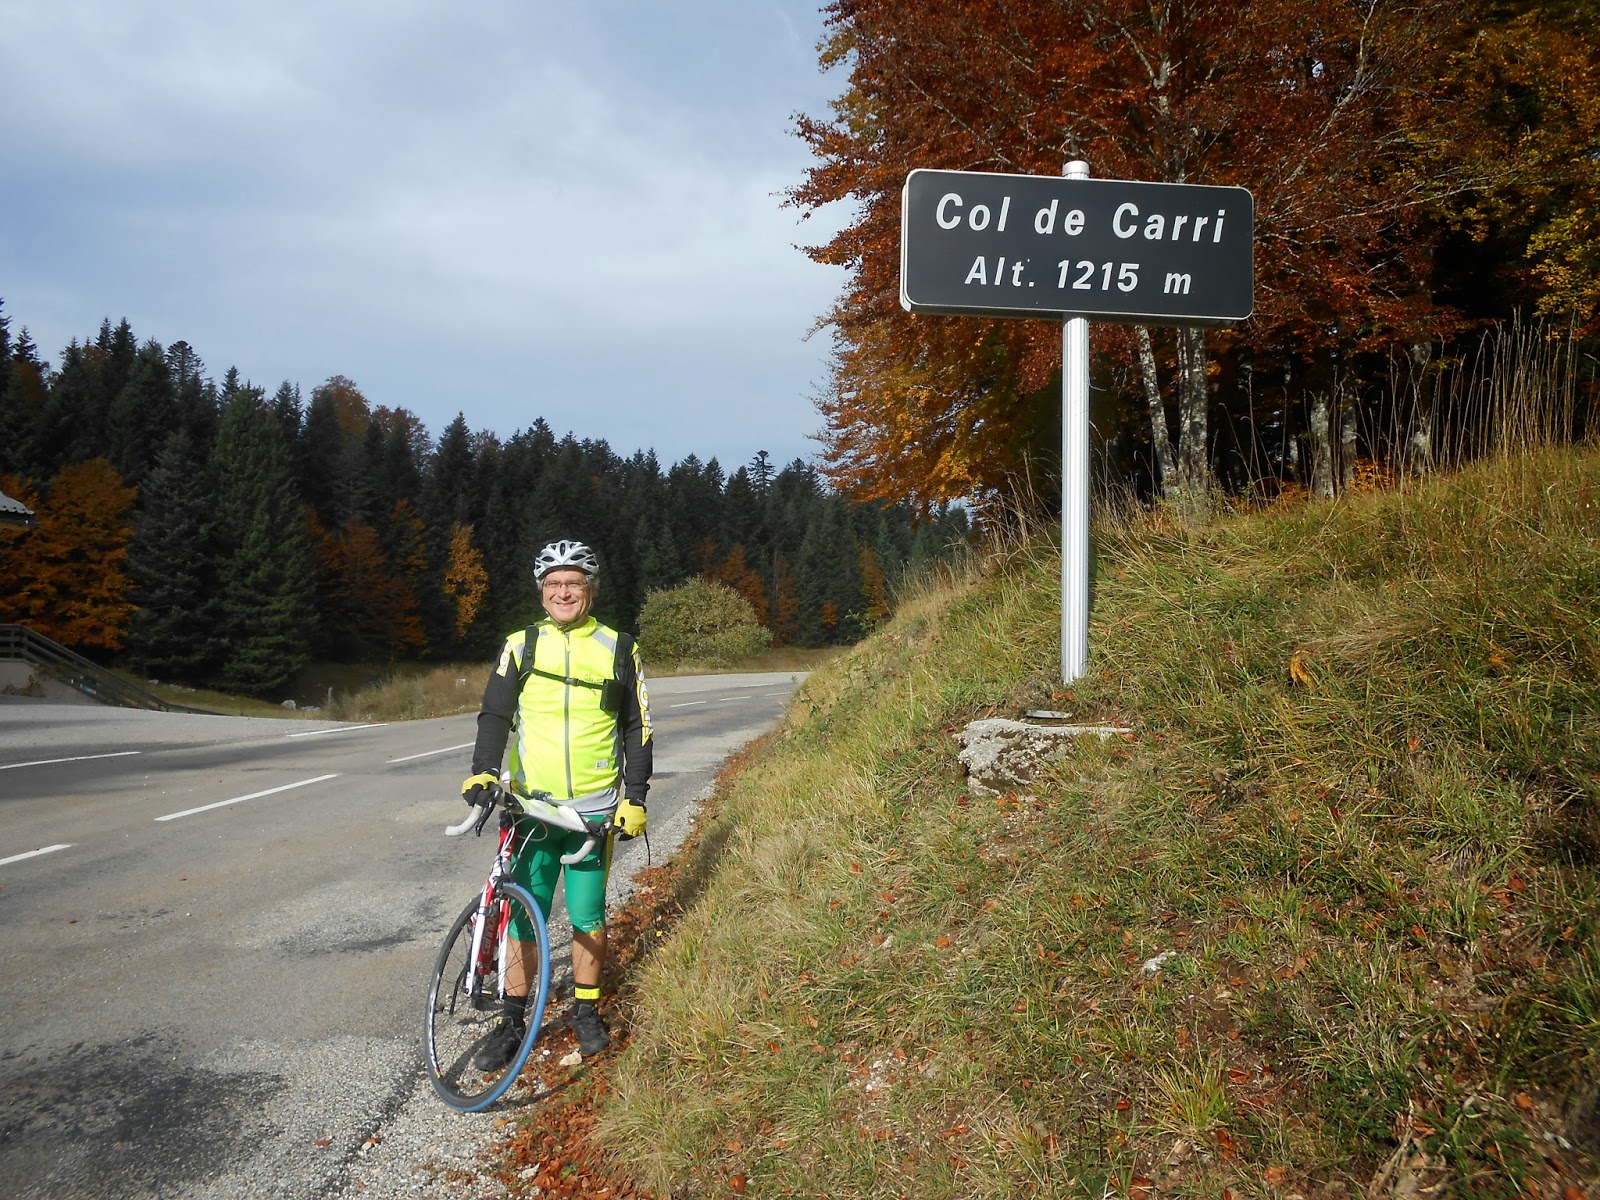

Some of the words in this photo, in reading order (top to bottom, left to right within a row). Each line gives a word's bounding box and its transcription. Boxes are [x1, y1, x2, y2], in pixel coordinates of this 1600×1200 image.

[935, 192, 1011, 232] Col
[1034, 198, 1086, 236] de
[1112, 202, 1226, 243] Carri
[964, 255, 1035, 288] Alt.
[1056, 259, 1140, 293] 1215
[1163, 271, 1193, 295] m
